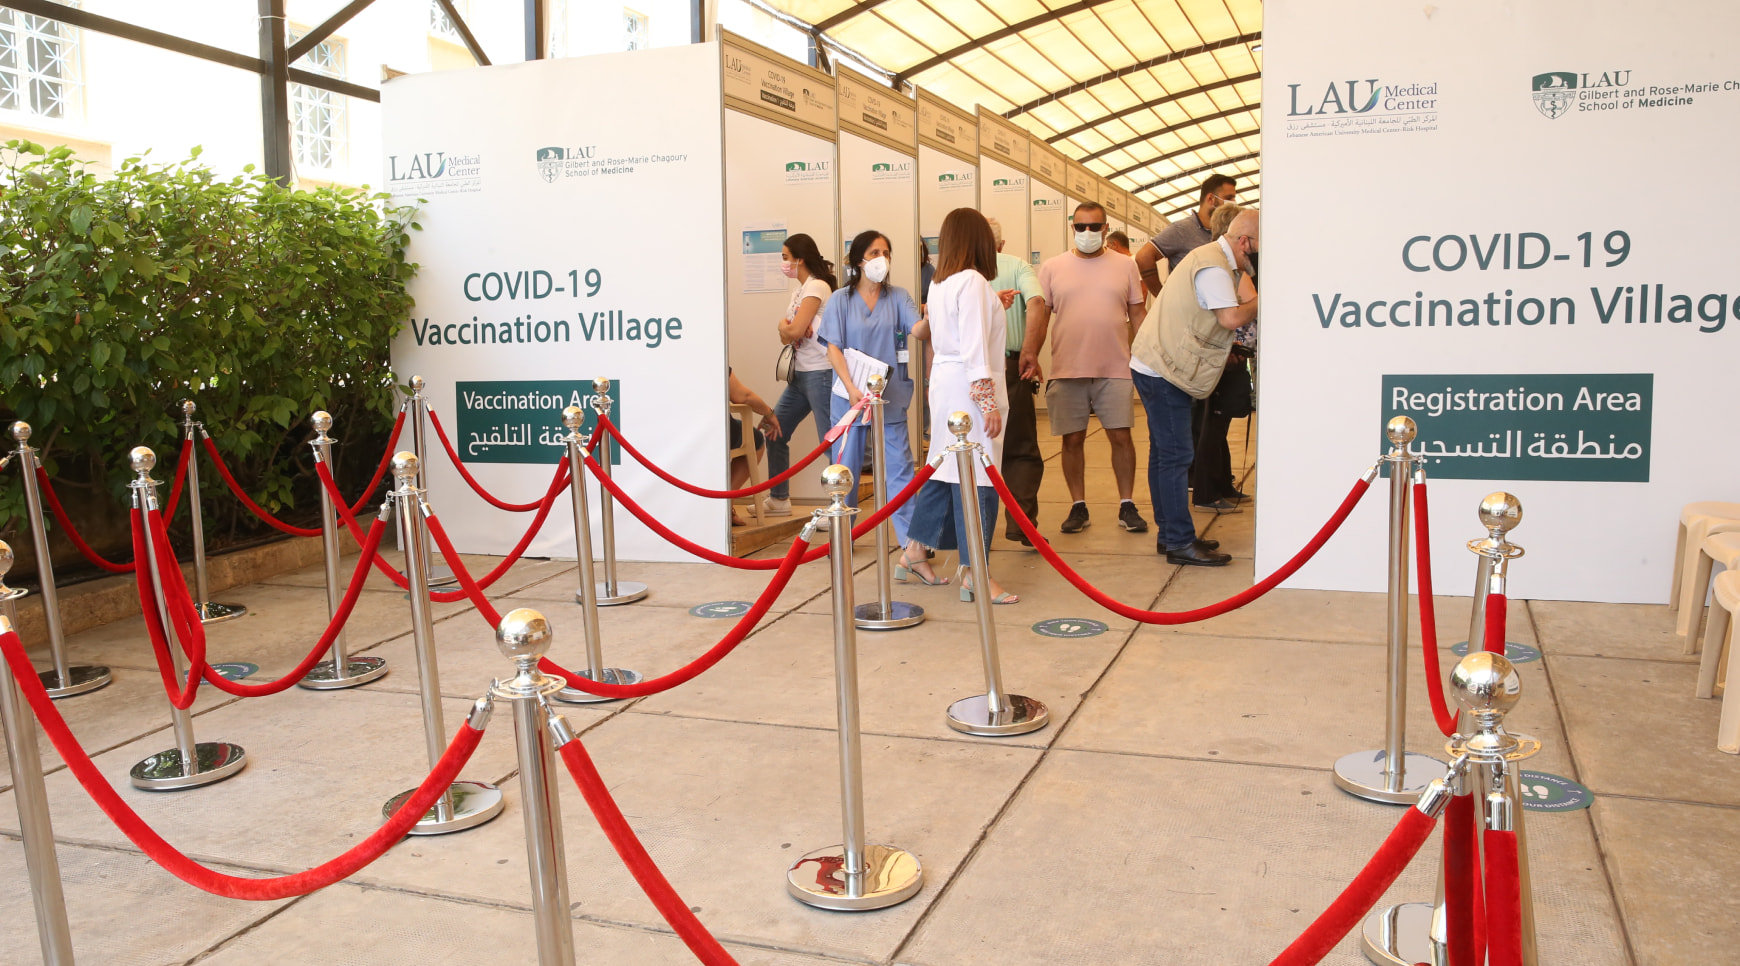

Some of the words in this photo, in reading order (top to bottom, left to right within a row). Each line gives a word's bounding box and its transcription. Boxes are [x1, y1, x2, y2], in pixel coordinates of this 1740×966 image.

[1580, 70, 1632, 89] LAU
[1287, 79, 1382, 117] LAU
[1384, 82, 1438, 98] Medical
[1578, 88, 1619, 101] Gilbert
[1623, 87, 1645, 98] and
[1649, 82, 1720, 96] Rose-Marie
[1384, 98, 1438, 111] Center
[1578, 102, 1619, 112] School
[1622, 100, 1634, 109] of
[1638, 96, 1694, 108] Medicine
[448, 154, 481, 167] Medical
[565, 161, 589, 169] Gilbert
[591, 159, 605, 167] and
[607, 156, 649, 166] Rose-Marie
[650, 153, 688, 163] Chagoury
[566, 146, 596, 160] LAU
[389, 152, 446, 181] LAU
[448, 166, 481, 177] Center
[565, 168, 589, 177] School
[592, 168, 599, 176] of
[601, 166, 634, 175] Medicine
[807, 161, 829, 171] LAU
[891, 163, 911, 172] LAU
[955, 173, 973, 181] LAU
[1008, 178, 1025, 186] LAU
[1401, 229, 1632, 272] COVID-19
[463, 268, 602, 302] COVID-19
[1311, 289, 1576, 329] Vaccination
[411, 314, 570, 346] Vaccination
[578, 310, 683, 349] Village
[463, 390, 564, 410] Vaccination
[1392, 386, 1564, 417] Registration
[1572, 386, 1642, 411] Area
[468, 423, 532, 456] التلقيح
[1527, 430, 1643, 459] منطقة
